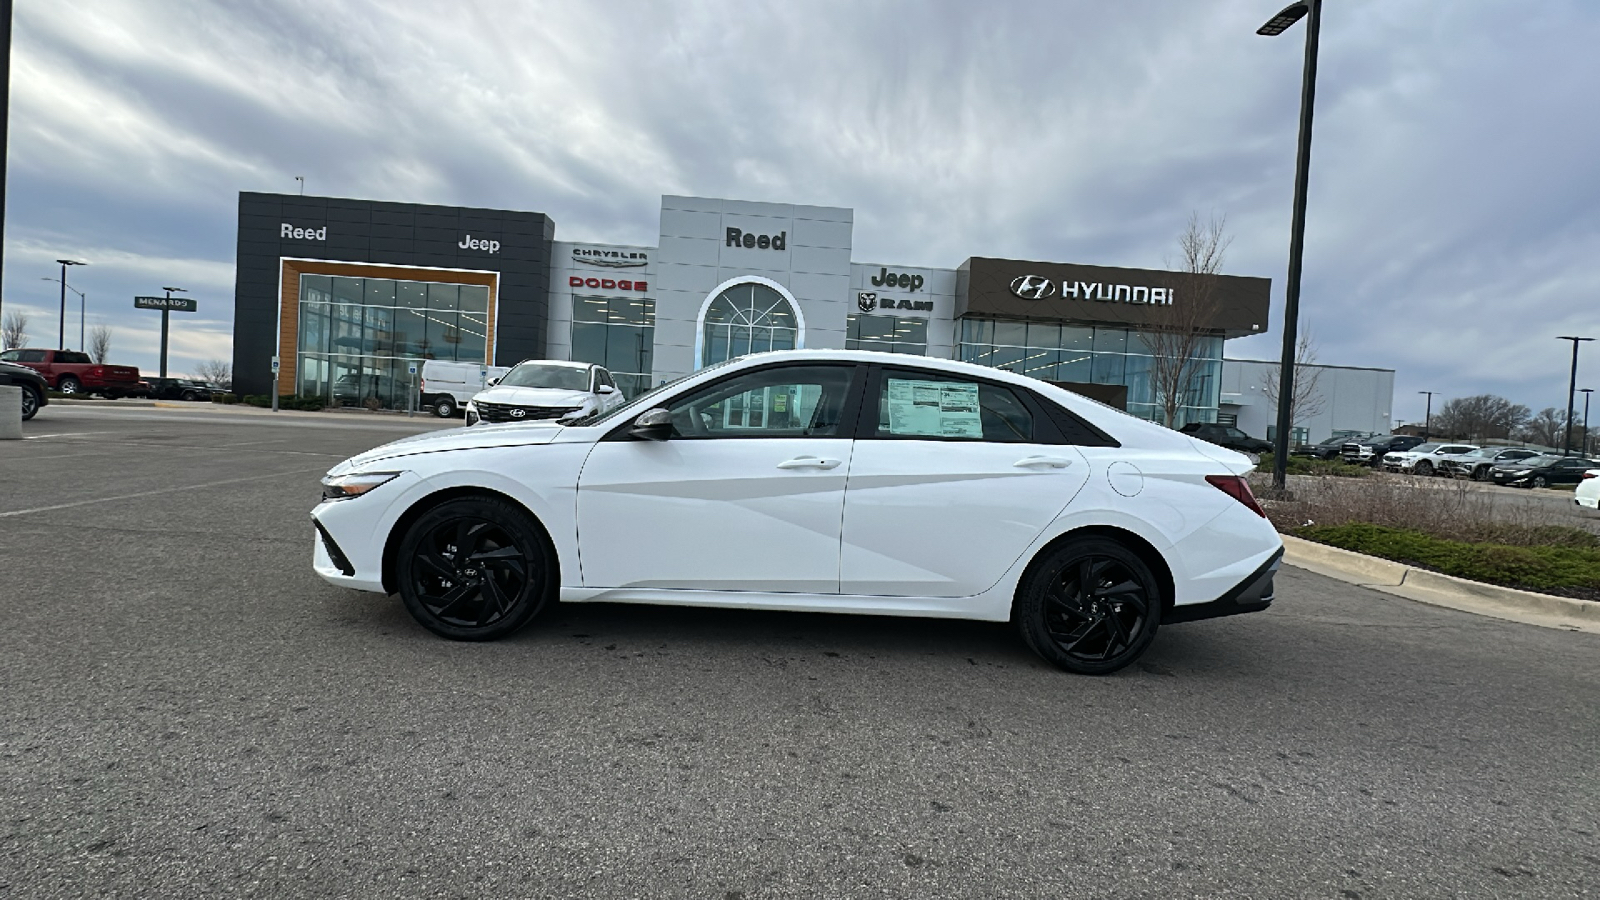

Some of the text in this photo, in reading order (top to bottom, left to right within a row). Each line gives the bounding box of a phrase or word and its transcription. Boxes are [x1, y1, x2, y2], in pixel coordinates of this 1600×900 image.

[281, 223, 327, 241] Reed
[726, 226, 786, 250] Reed
[458, 234, 500, 254] Jeep
[573, 249, 647, 260] CHRYSLER
[569, 276, 648, 292] DODGE
[871, 267, 924, 292] Jeep
[139, 298, 188, 307] MENARDS
[1062, 281, 1174, 306] HYUNDAI
[880, 298, 933, 311] RAM
